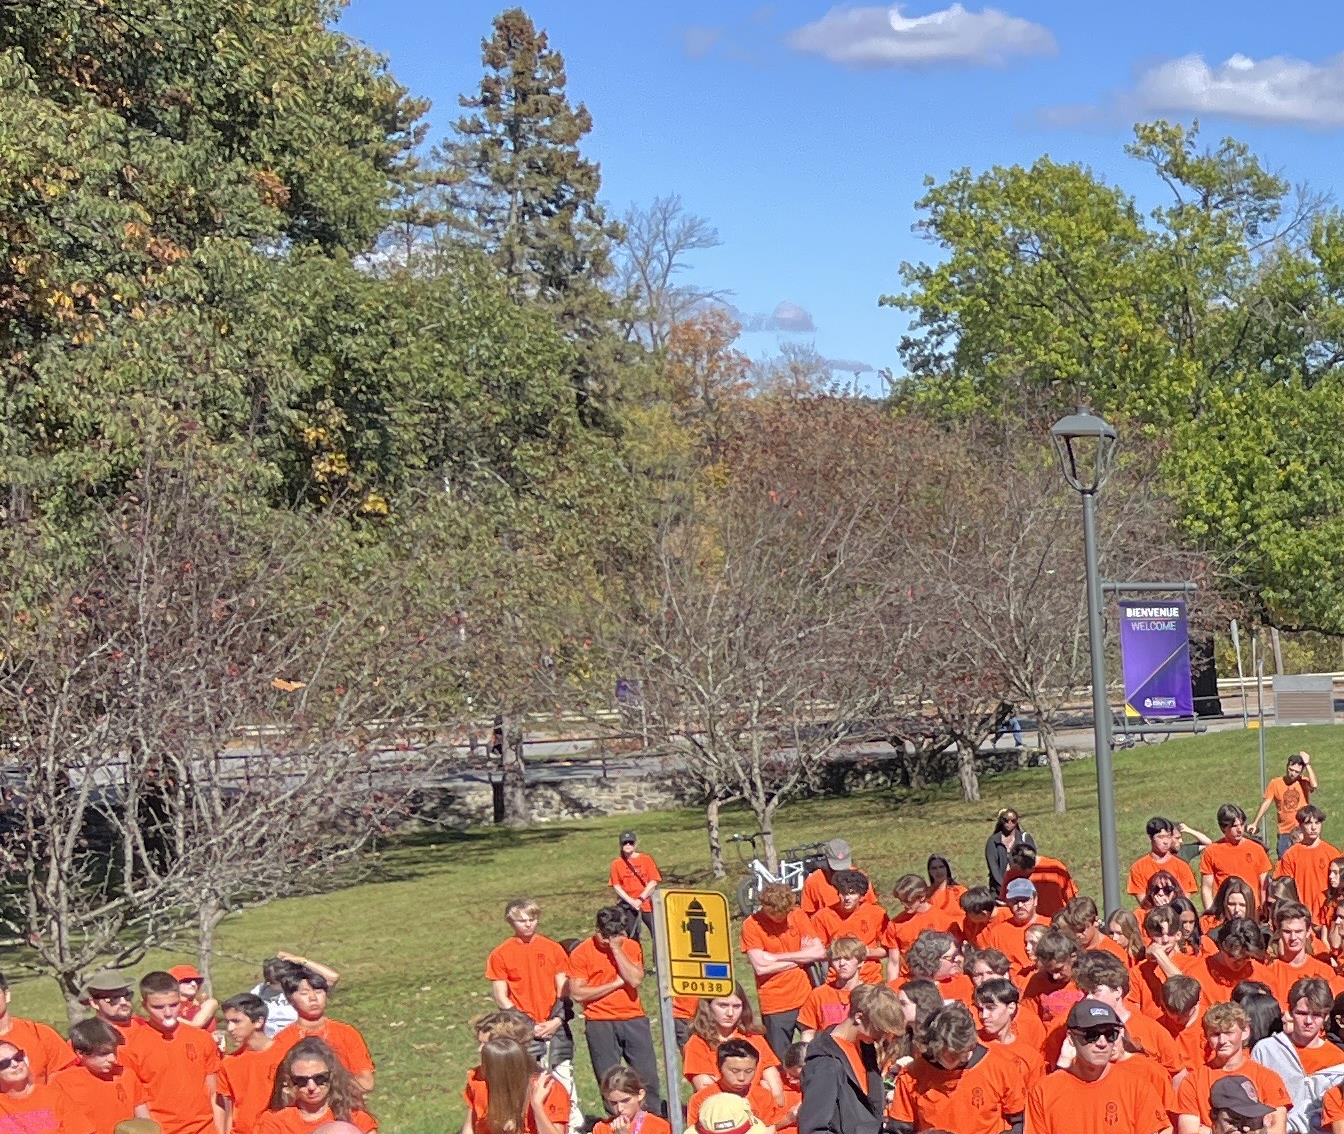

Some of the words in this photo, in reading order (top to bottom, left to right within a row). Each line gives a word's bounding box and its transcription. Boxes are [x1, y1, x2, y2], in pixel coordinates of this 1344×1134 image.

[1126, 608, 1179, 617] BIENVENUE
[1131, 621, 1176, 631] WELCOME
[682, 981, 723, 992] P0138
